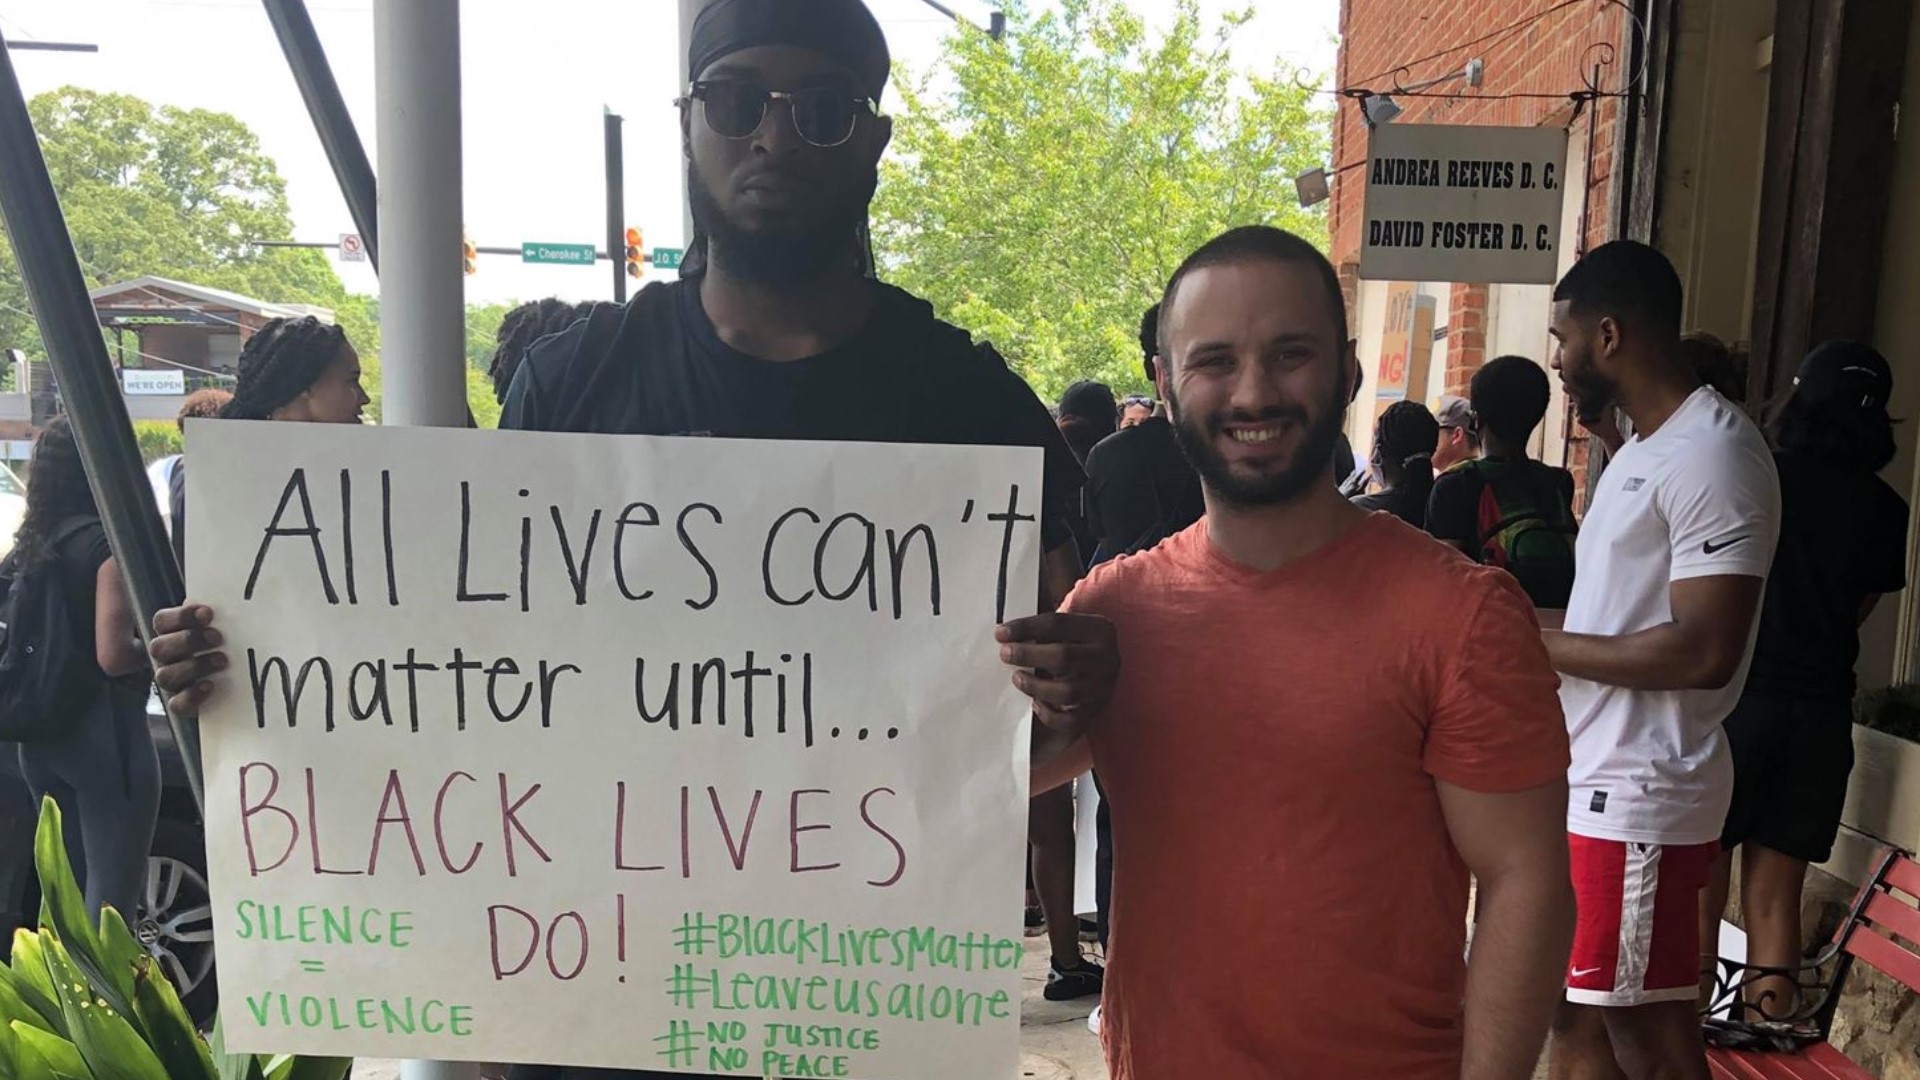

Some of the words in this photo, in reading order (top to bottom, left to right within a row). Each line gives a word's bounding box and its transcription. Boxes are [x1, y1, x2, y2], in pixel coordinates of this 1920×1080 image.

[1372, 158, 1440, 186] ANDREA
[1447, 160, 1514, 189] REEVES
[1520, 162, 1536, 189] D.
[1543, 162, 1558, 190] C.
[538, 248, 580, 260] Cherokee
[584, 249, 594, 261] St
[1369, 220, 1425, 247] DAVID
[1431, 222, 1504, 250] FOSTER
[1511, 224, 1528, 250] D.
[1535, 224, 1553, 251] C.
[156, 381, 182, 389] OPEN
[245, 469, 399, 606] All
[457, 482, 722, 612] Lives
[763, 484, 1036, 625] can't
[248, 649, 580, 732] matter
[635, 652, 900, 748] until...
[239, 762, 552, 877] BLACK
[615, 781, 905, 887] LIVES
[236, 900, 413, 947] SILENCE
[488, 894, 626, 984] DO!
[672, 911, 1024, 971] #BlackLivesMatter
[246, 992, 472, 1036] VIOLENCE
[764, 1023, 880, 1050] JUSTICE
[708, 1046, 748, 1071] NO
[762, 1051, 849, 1077] PEACE
